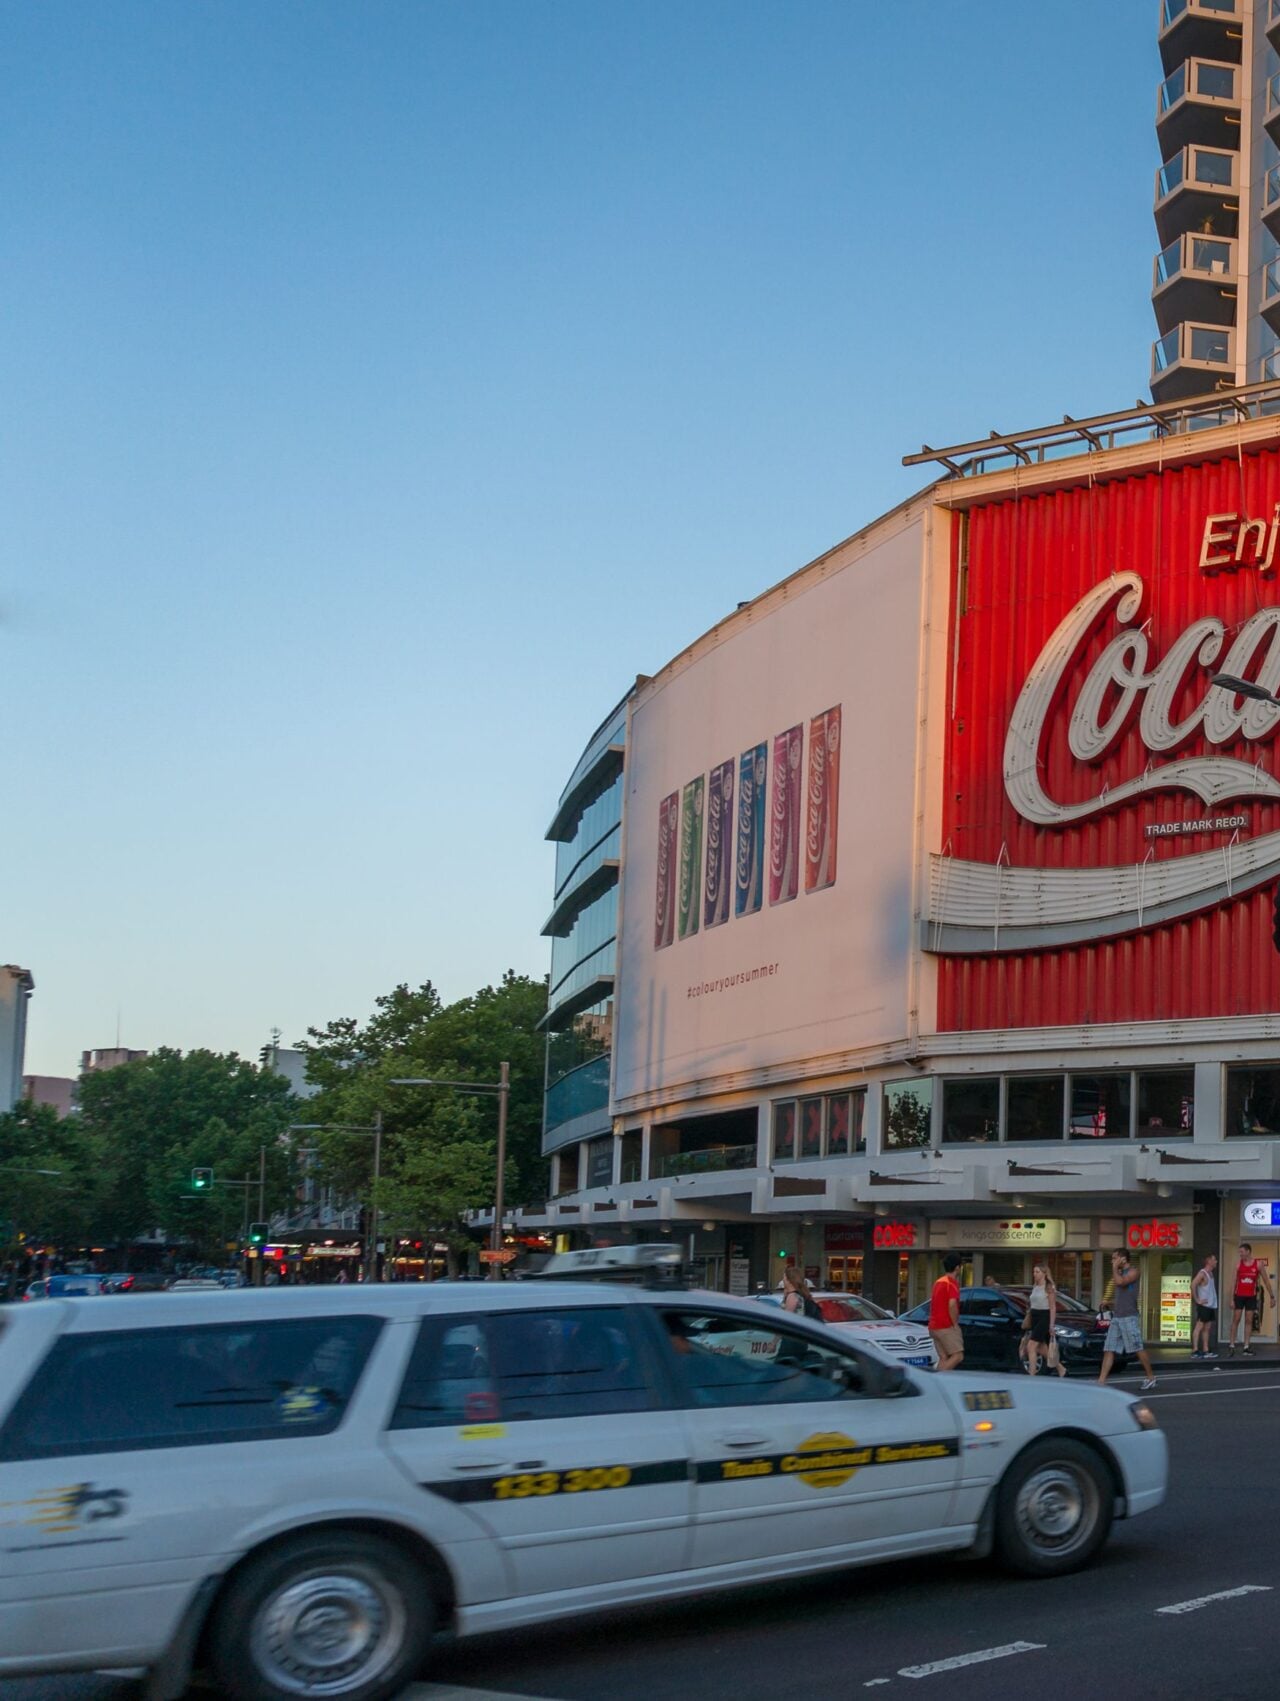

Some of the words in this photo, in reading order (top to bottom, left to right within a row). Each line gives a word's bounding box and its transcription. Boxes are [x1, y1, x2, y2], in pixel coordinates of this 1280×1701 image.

[1146, 823, 1181, 836] TRADE
[1182, 819, 1213, 832] MARK
[1215, 816, 1247, 829] REGD.
[687, 963, 779, 999] #colouryoursummer
[873, 1219, 915, 1247] coles
[1127, 1217, 1180, 1248] coles
[492, 1472, 560, 1499] 133
[562, 1463, 632, 1493] 300
